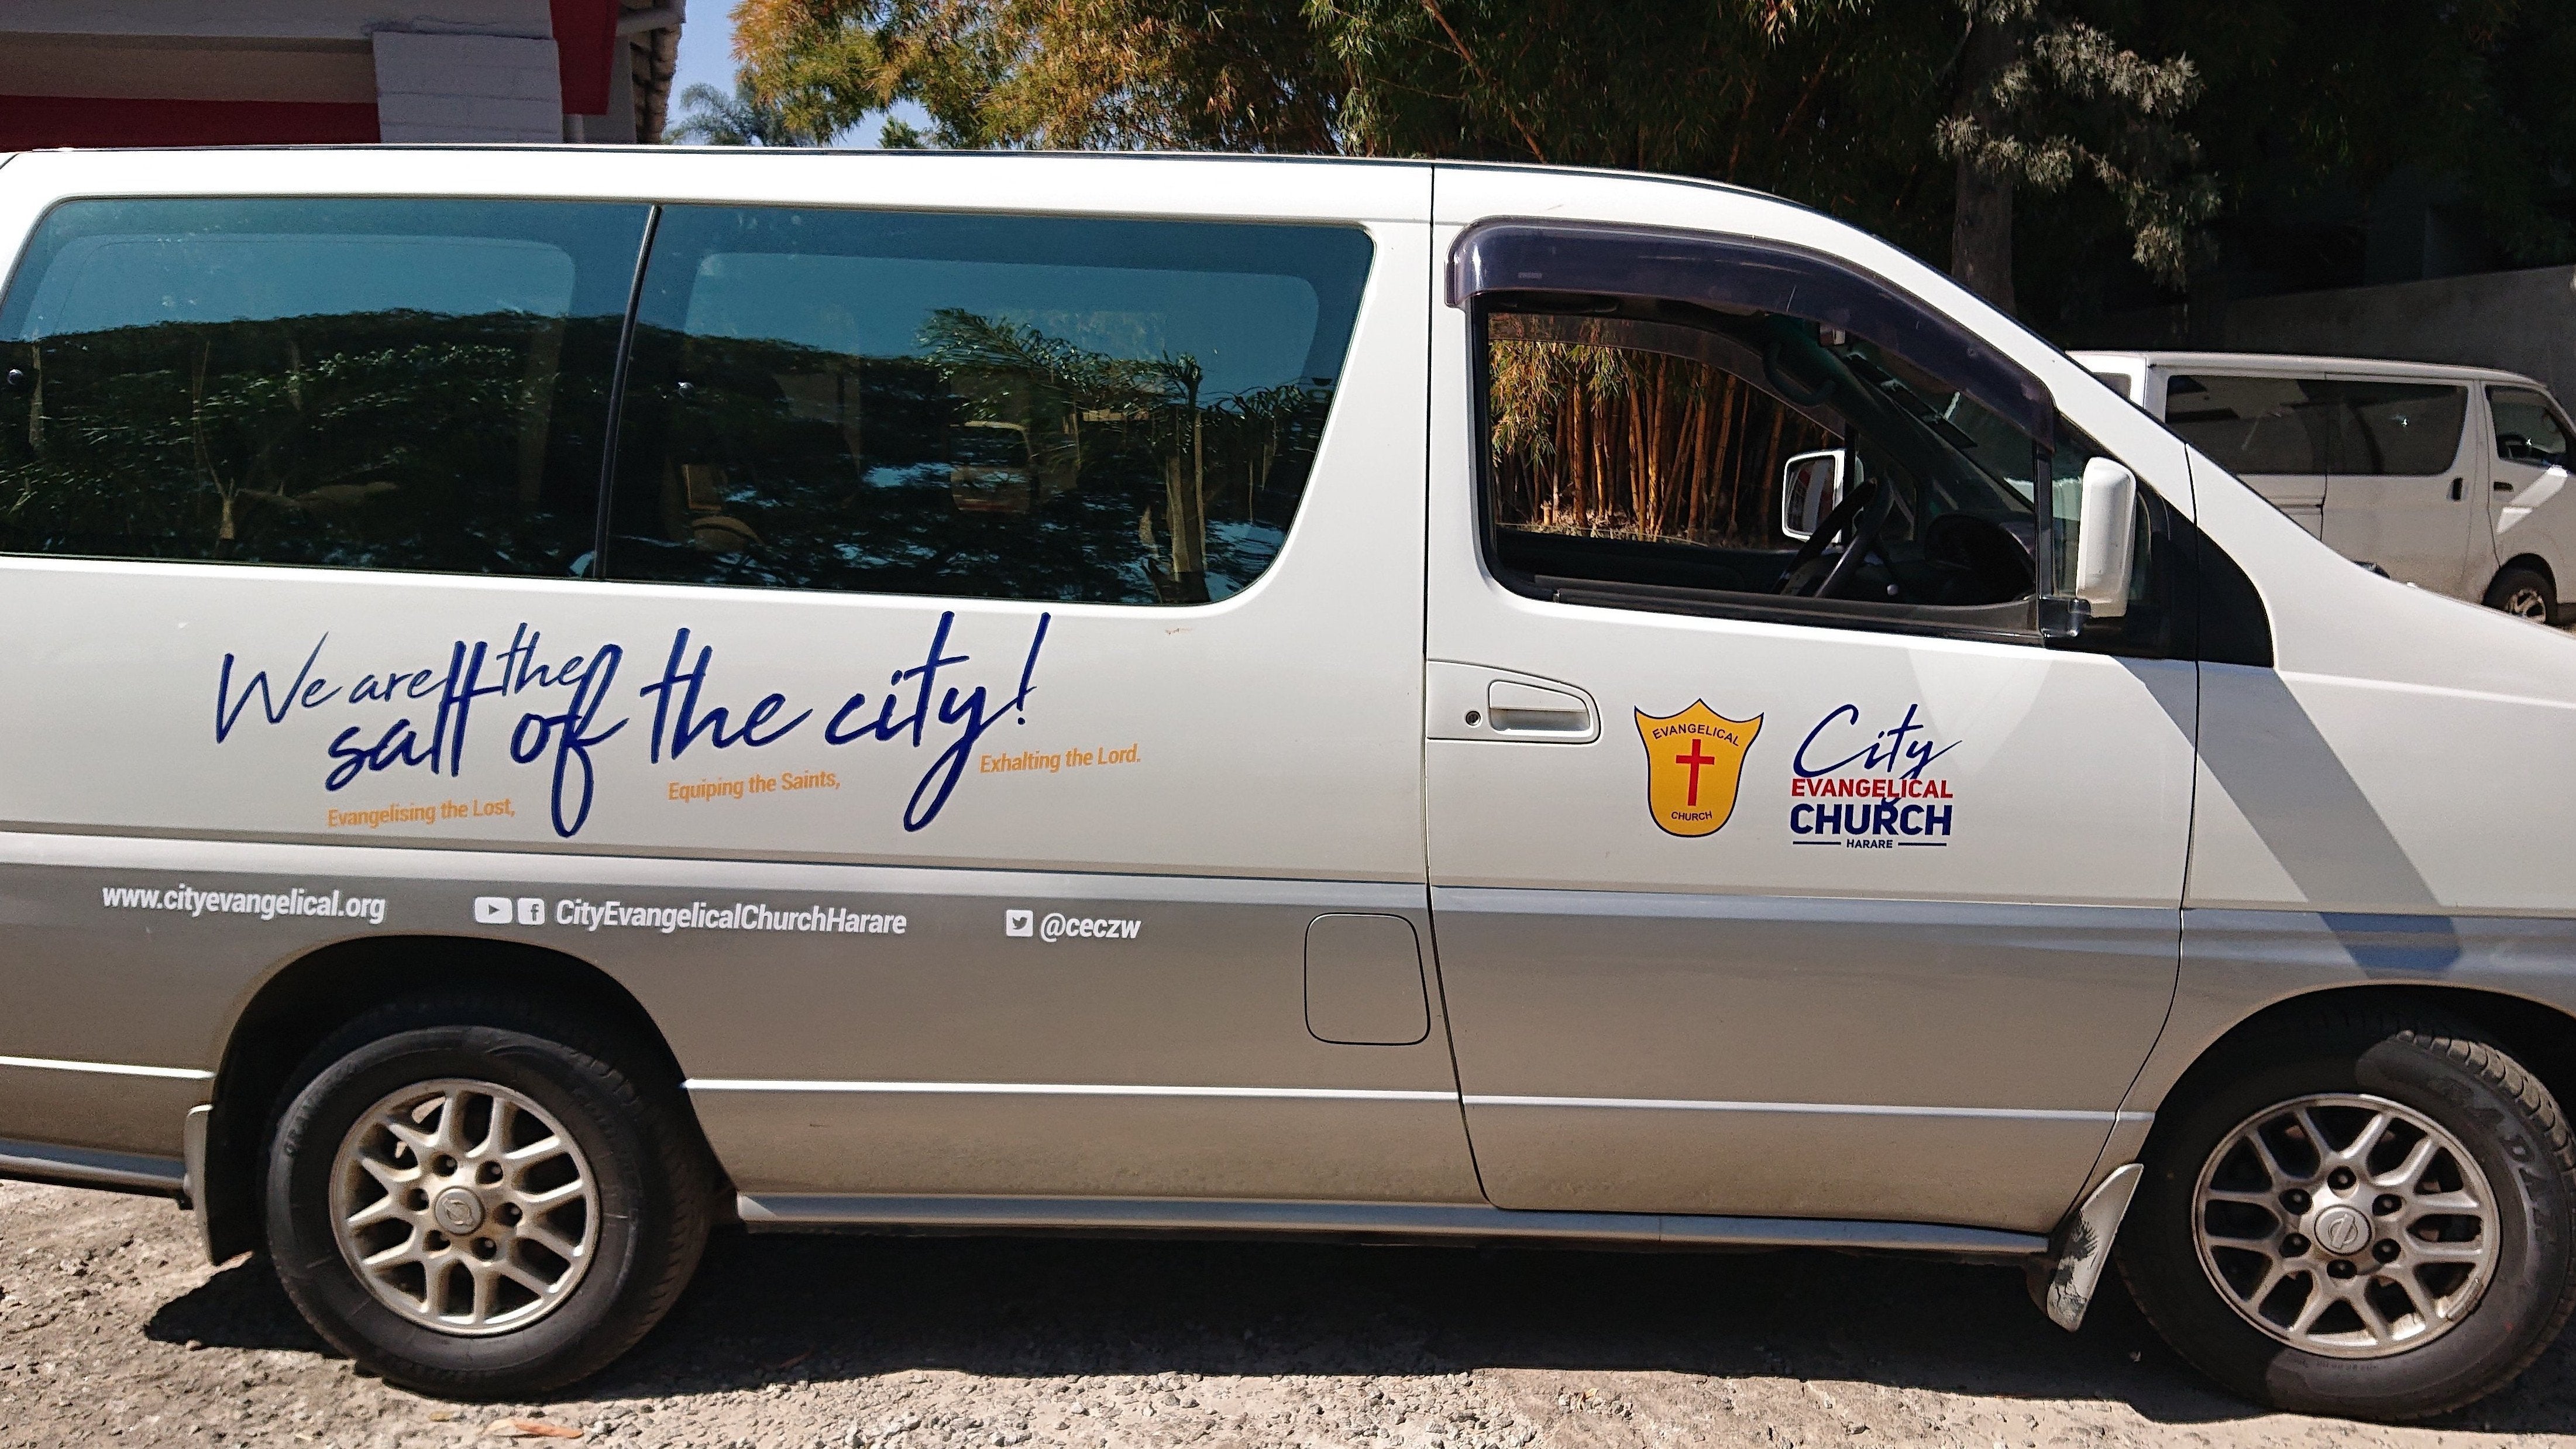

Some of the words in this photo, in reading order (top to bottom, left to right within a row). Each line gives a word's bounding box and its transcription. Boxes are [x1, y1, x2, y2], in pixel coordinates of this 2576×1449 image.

[216, 631, 344, 744] We
[349, 669, 447, 704] are
[496, 622, 586, 697] the
[325, 641, 503, 791] salt
[510, 643, 630, 838] of
[640, 627, 813, 764] the
[824, 611, 1052, 832] city!
[1652, 723, 1739, 747] EVANGELICAL
[1793, 703, 1963, 779] City
[979, 751, 1061, 774] Exhalting
[1065, 747, 1093, 767] the
[1097, 743, 1140, 765] Lord.
[668, 778, 744, 803] Equiping
[748, 774, 777, 794] the
[780, 770, 840, 791] Saints,
[1791, 778, 1954, 799] EVANGELICAL
[328, 803, 436, 829] Evangelising
[440, 799, 469, 819] the
[472, 798, 515, 818] Lost,
[1671, 811, 1712, 821] CHURCH
[1790, 804, 1953, 835] CHURCH
[1846, 839, 1893, 849] HARARE
[102, 883, 387, 925] www.cityevangelical.org
[556, 898, 907, 935] CityEvangelicalChurchHarare
[1040, 912, 1141, 943] @ceczw
